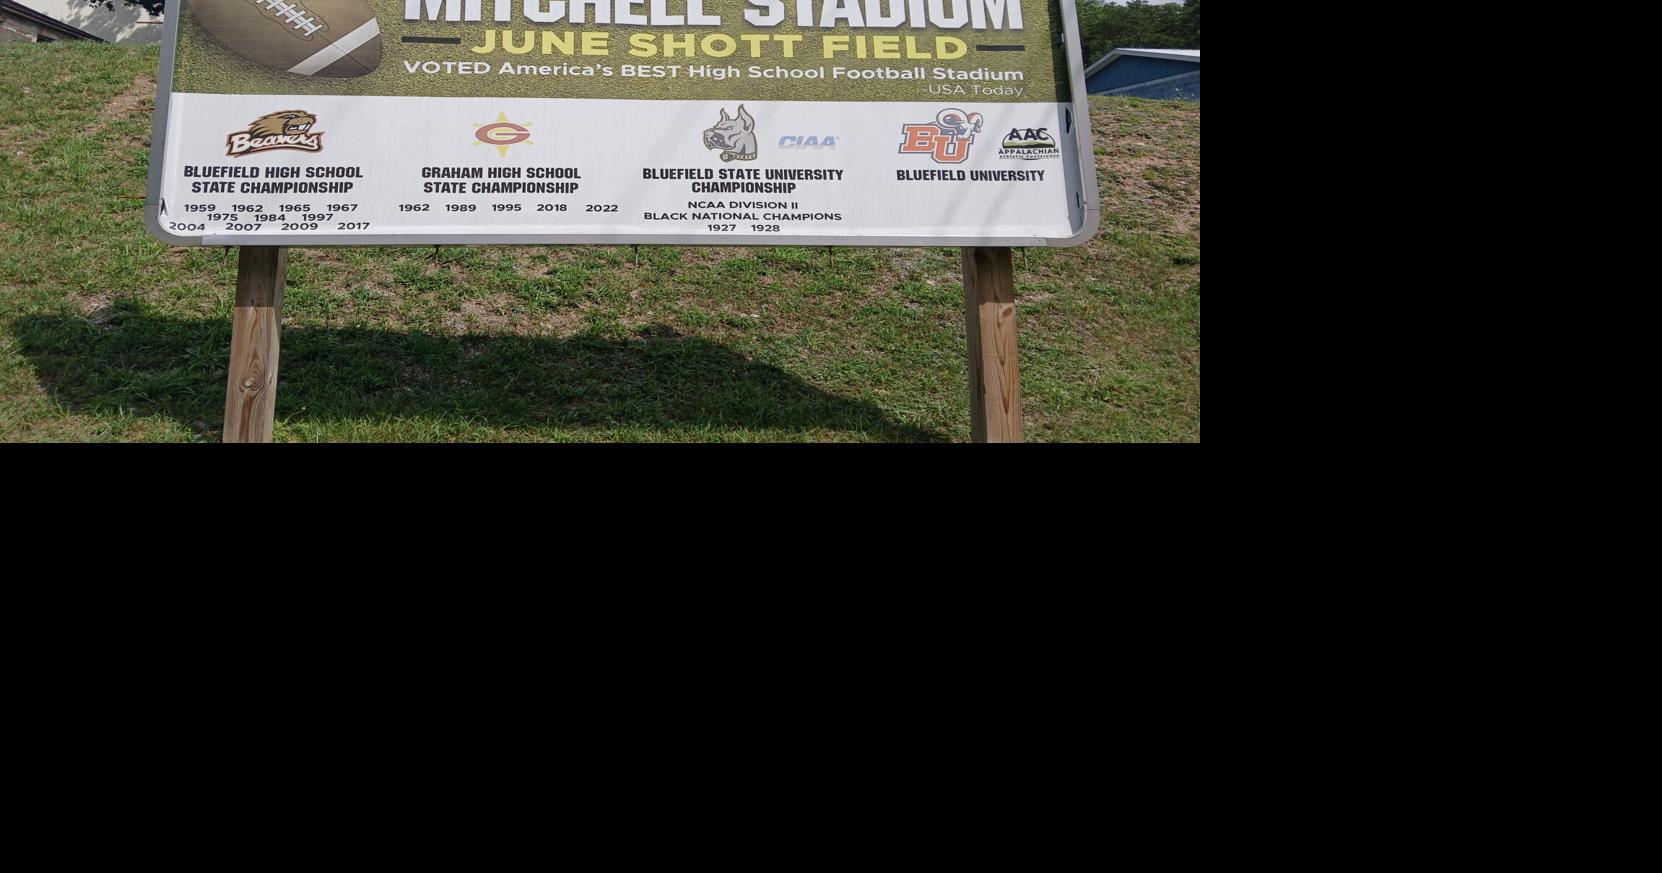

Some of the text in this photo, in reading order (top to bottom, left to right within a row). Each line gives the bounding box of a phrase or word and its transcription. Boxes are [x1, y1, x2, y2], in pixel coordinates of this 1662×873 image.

[471, 29, 968, 60] JUNE SHOTT FIELD
[403, 60, 1024, 82] VOTED America's BEST High School Football Stadium
[971, 84, 1024, 97] Today
[475, 122, 531, 145] G
[1008, 127, 1050, 141] AAC
[231, 132, 320, 153] Beavers
[778, 135, 837, 149] CIAA
[898, 123, 975, 165] BU
[184, 166, 364, 179] BLUEFIELD HIGH SCHOOL
[421, 167, 582, 179] GRAHAM HIGH SCHOOL
[642, 168, 844, 181] BLUEFIELD STATE UNIVERSITY
[896, 169, 1045, 182] BLUEFIELD UNIVERSITY
[192, 181, 354, 194] STATE CHAMPIONSHIP
[423, 182, 579, 194] STATE CHAMPIONSHIP
[691, 182, 797, 194] CHAMPIONSHIP
[184, 203, 359, 213] 1959 1962 1965 1967
[398, 203, 619, 213] 1962 1989 1995 2018 2022
[688, 201, 725, 209] NCAA
[730, 201, 788, 209] DIVISION
[207, 213, 334, 222] 1975 1984 1997
[644, 212, 842, 221] BLACK NATIONAL CHAMPIONS
[169, 222, 370, 231] 2004 2007 2009 2017
[707, 224, 780, 232] 1927 1928
